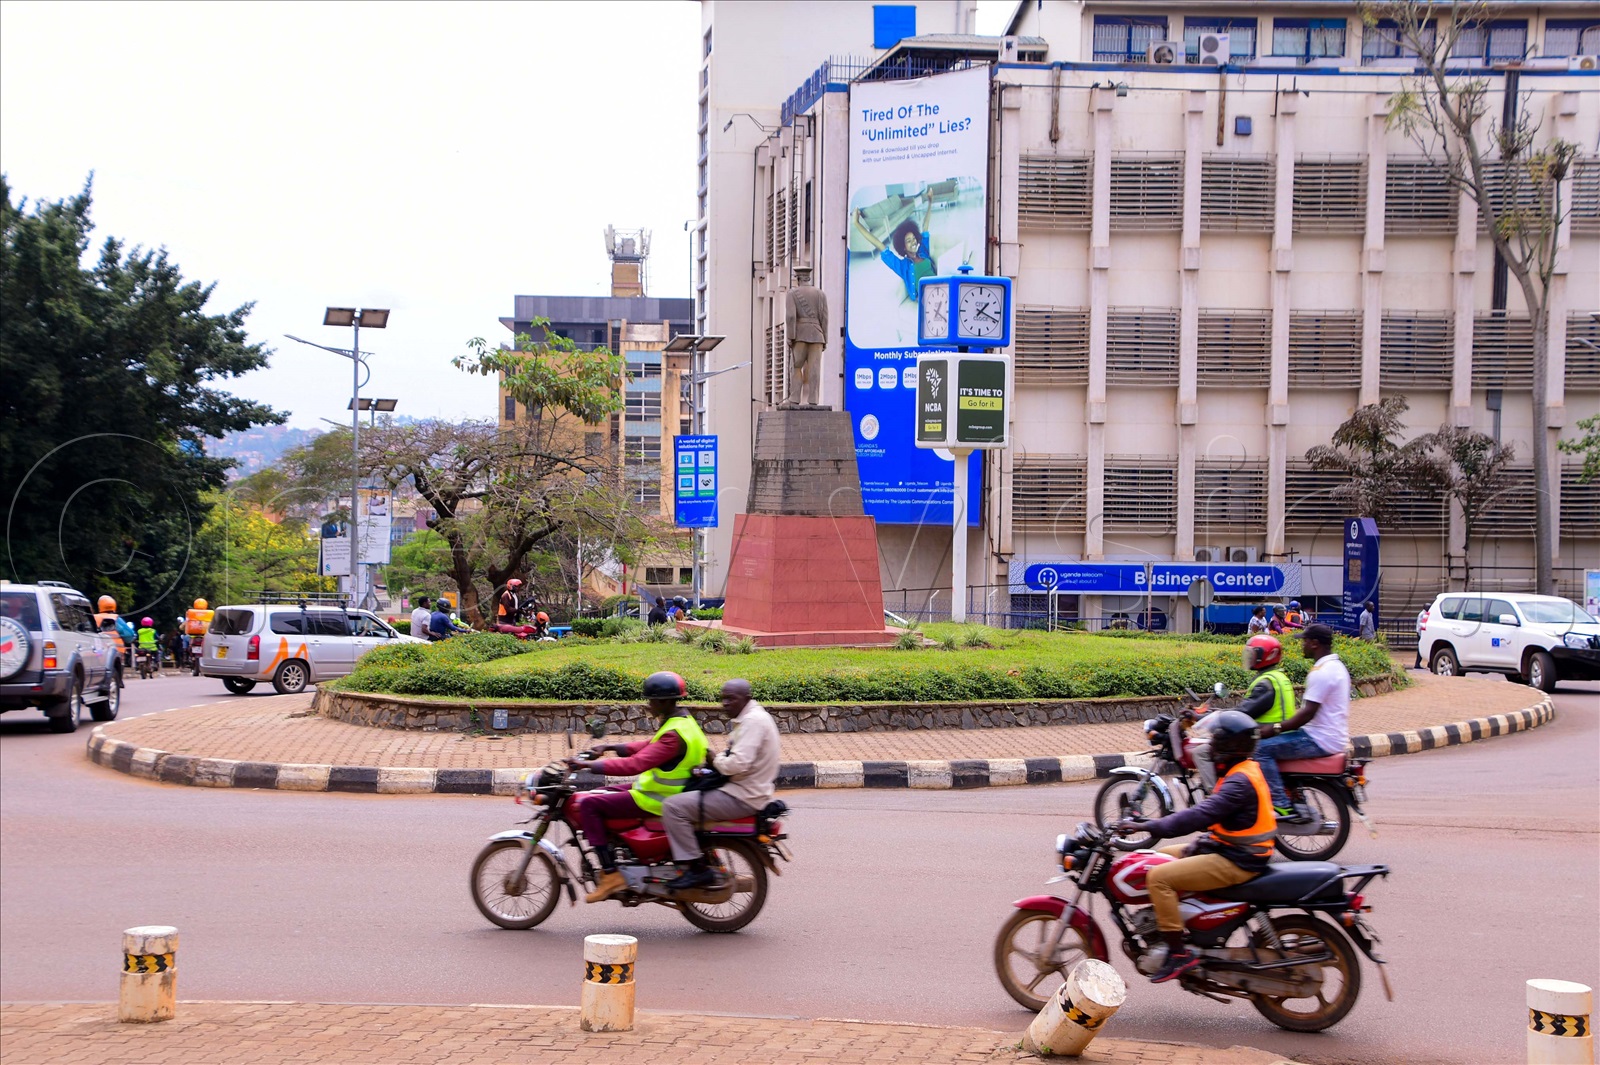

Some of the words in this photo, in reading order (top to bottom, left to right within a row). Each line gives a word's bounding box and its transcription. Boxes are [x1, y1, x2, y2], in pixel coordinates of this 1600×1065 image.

[862, 107, 894, 122] Tired
[897, 104, 912, 119] Of
[916, 103, 940, 117] The
[939, 117, 972, 134] Lies?
[885, 145, 909, 153] download
[882, 154, 906, 162] Unlimited
[911, 151, 937, 159] Uncapped
[874, 350, 902, 360] Monthly
[960, 387, 973, 396] IT'S
[974, 388, 991, 397] TIME
[993, 389, 1003, 397] TO
[925, 402, 942, 412] NCBA
[1213, 571, 1272, 586] Center
